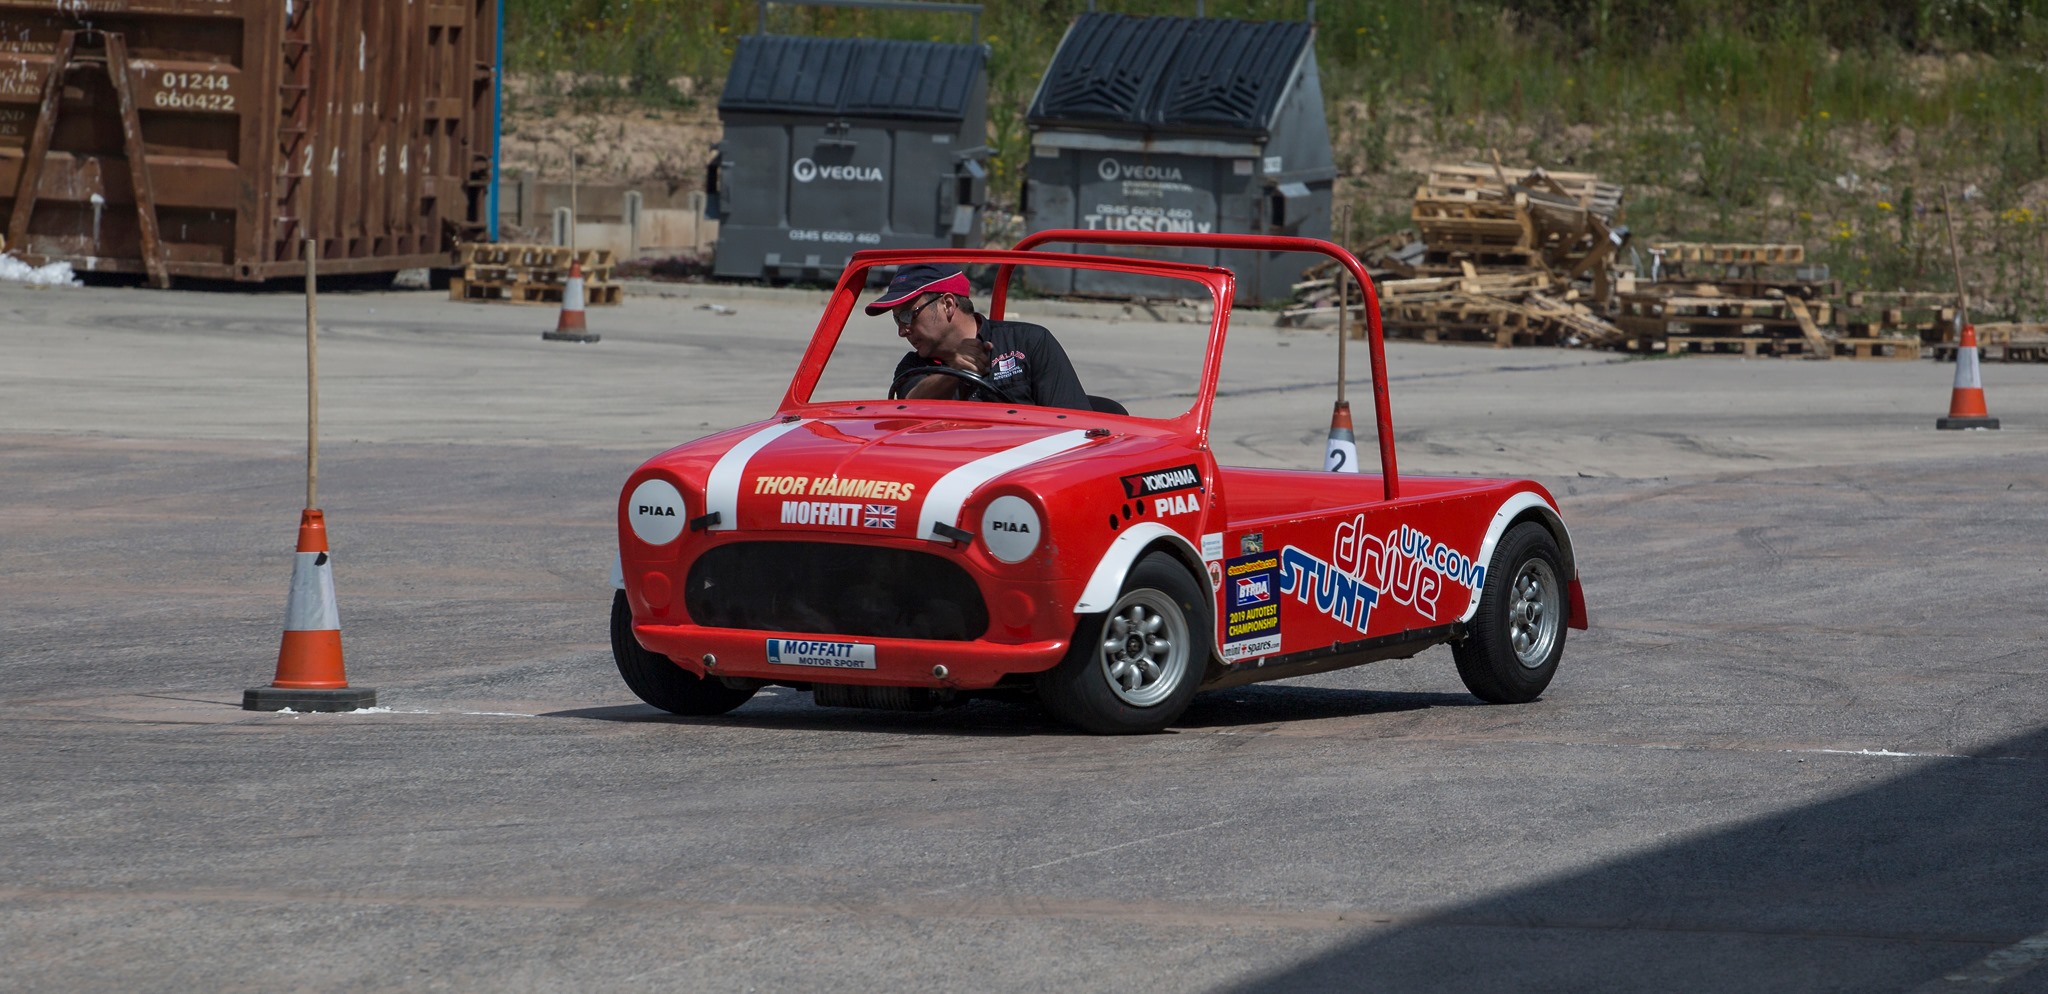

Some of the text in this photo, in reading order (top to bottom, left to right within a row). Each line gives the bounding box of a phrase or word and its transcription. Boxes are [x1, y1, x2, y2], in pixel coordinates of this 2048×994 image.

[162, 71, 230, 91] 01244
[154, 90, 235, 111] 660422
[819, 165, 883, 181] VEOLIA
[1121, 165, 1182, 180] VEOLIA
[1330, 448, 1346, 472] 2
[754, 476, 915, 501] THOR HAMMERS
[1142, 468, 1198, 491] YOKOHAMA
[639, 505, 676, 517] PIAA
[781, 501, 862, 527] MOFFATT
[1154, 493, 1200, 518] PIAA
[992, 520, 1030, 533] PIAA
[1334, 513, 1442, 622] drive
[1400, 523, 1486, 591] UK.COM
[1239, 581, 1268, 599] BTRDA
[1280, 544, 1380, 635] STUNT
[1229, 604, 1278, 624] 2019 AUTOTEST
[1228, 616, 1278, 637] CHAMPIONSHIP
[783, 640, 854, 658] MOFFATT
[799, 656, 866, 668] MOTOR SPORT
